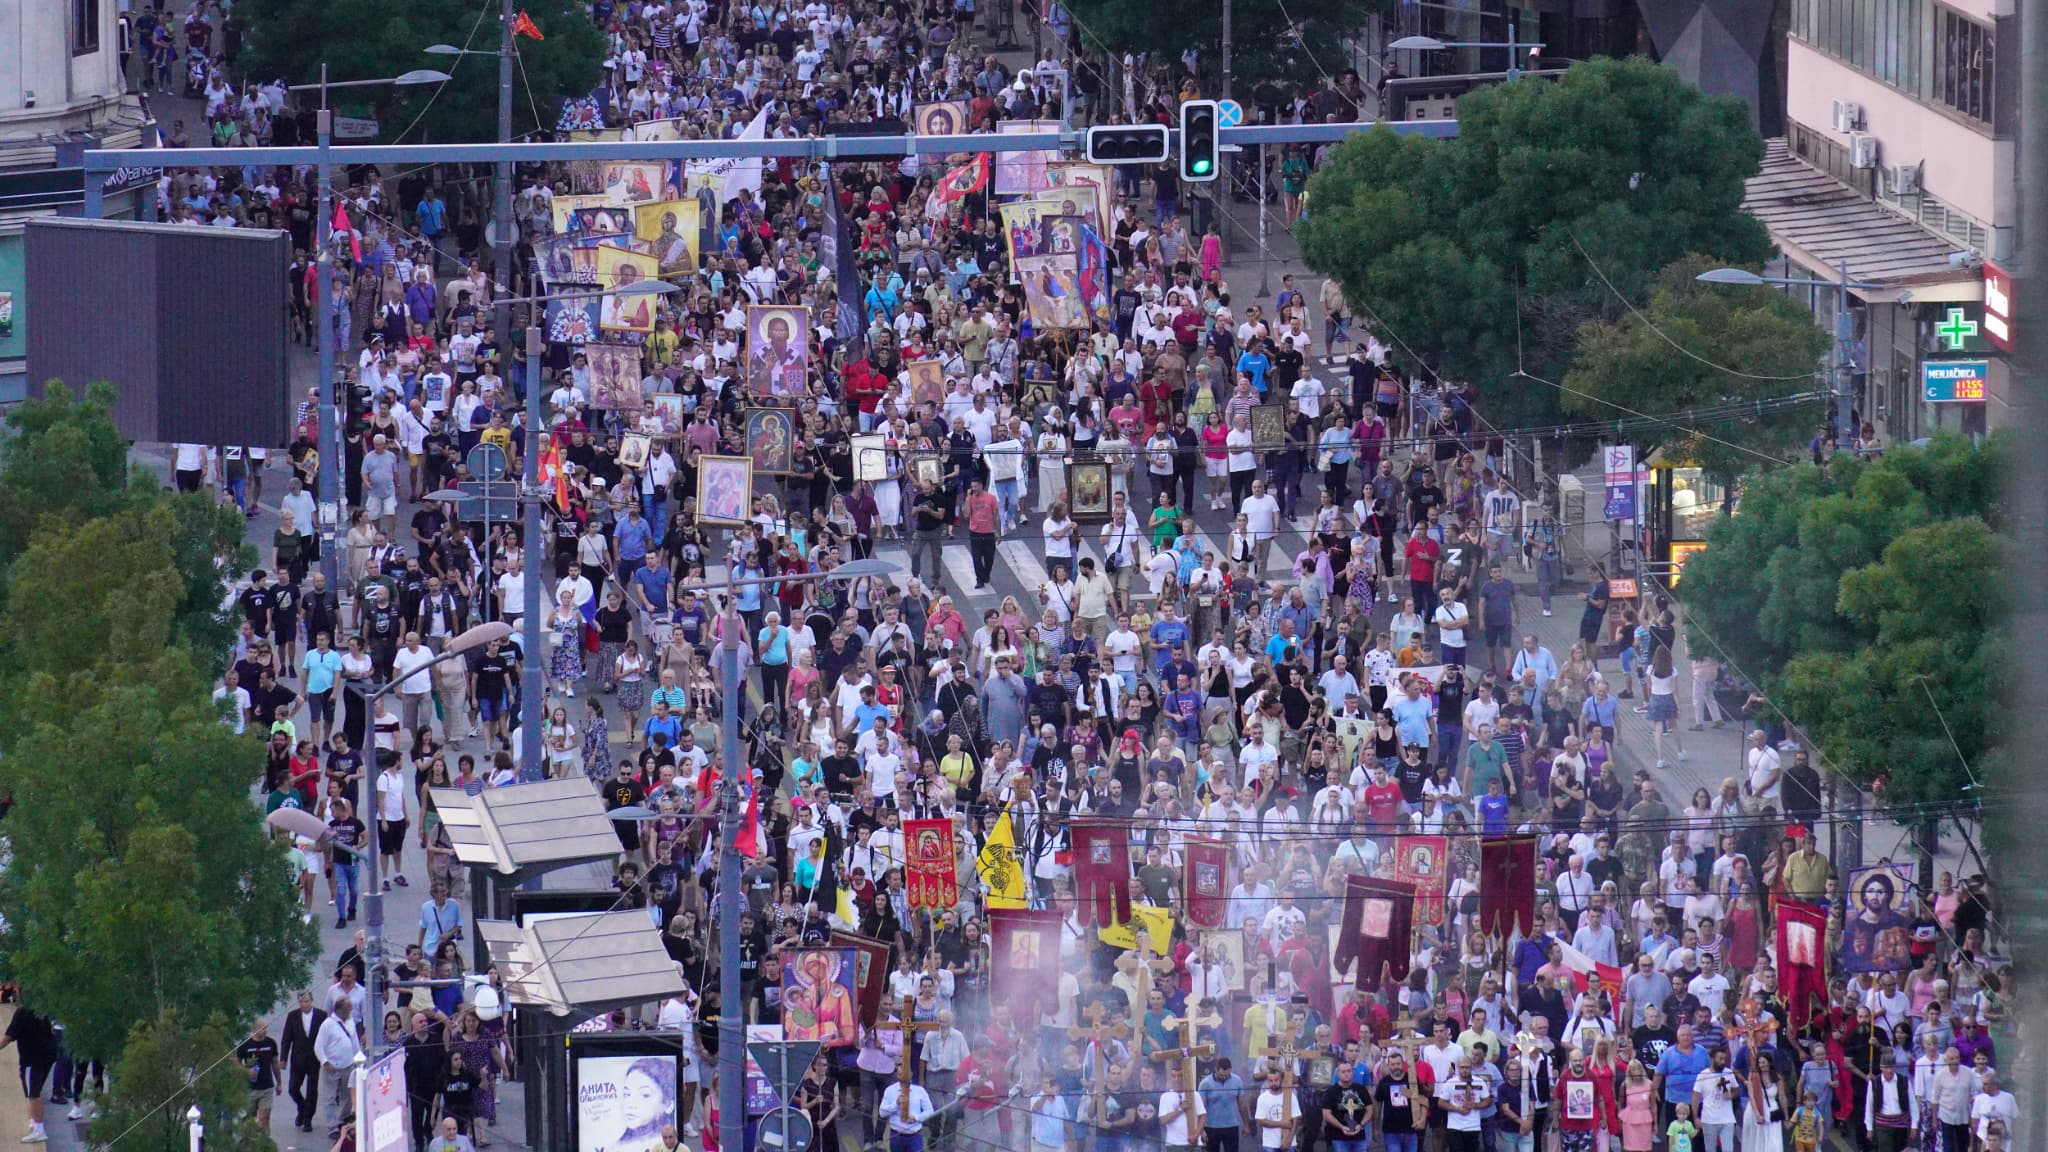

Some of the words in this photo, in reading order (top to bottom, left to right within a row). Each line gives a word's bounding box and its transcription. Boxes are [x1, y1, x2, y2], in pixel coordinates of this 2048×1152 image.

[1928, 367, 1976, 379] MENJAČNICA
[1927, 387, 1937, 397] €
[1447, 548, 1462, 565] Z
[580, 1082, 617, 1095] АНИТА
